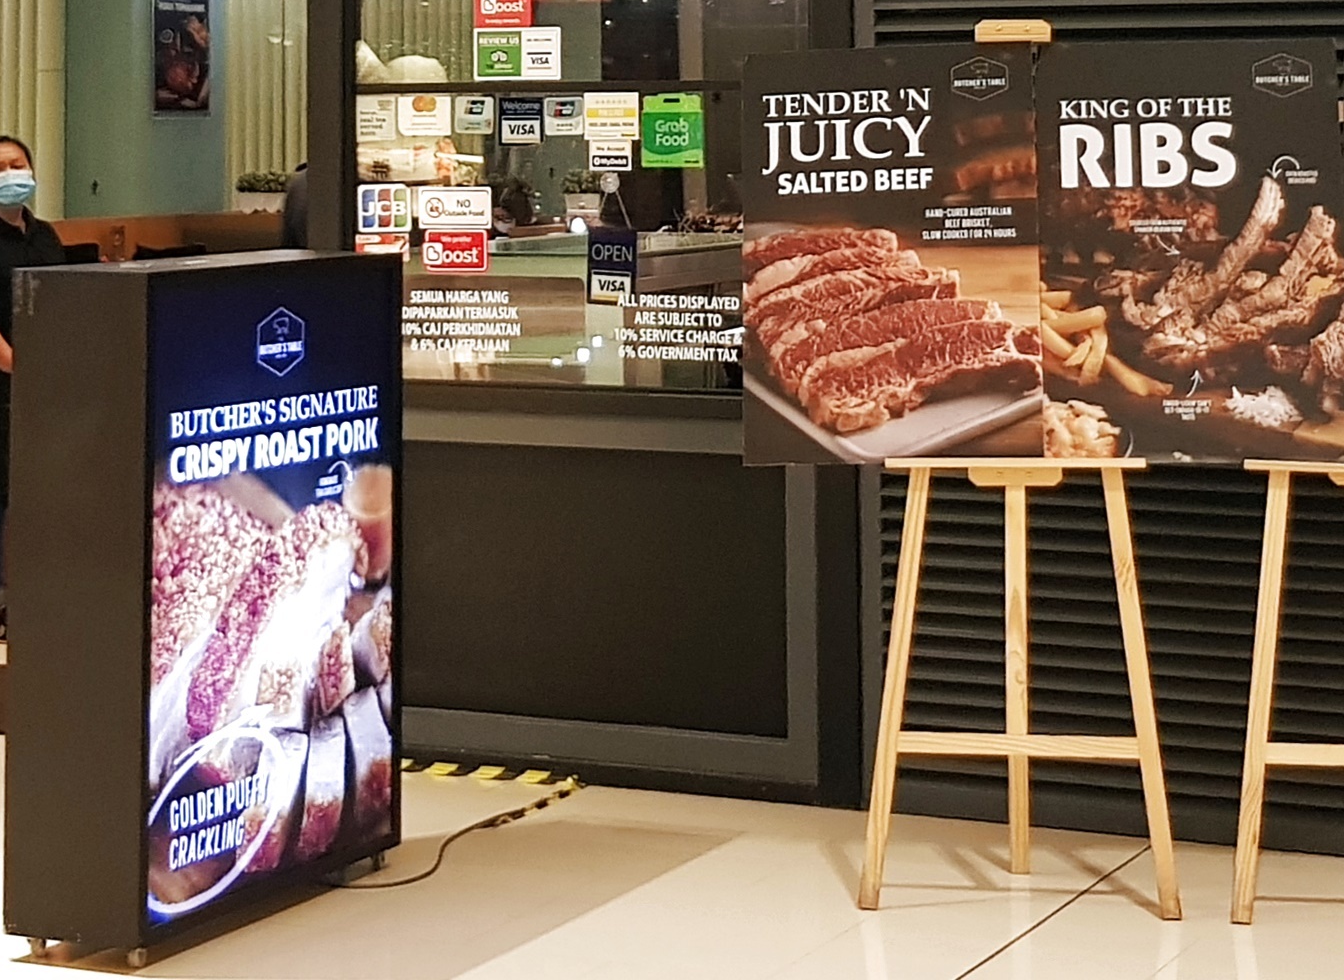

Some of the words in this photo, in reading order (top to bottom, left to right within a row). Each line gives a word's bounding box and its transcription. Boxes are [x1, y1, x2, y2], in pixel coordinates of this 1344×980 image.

[479, 36, 507, 45] REVIEW
[509, 35, 520, 45] US
[531, 57, 550, 65] VISA
[502, 100, 541, 111] Welcome
[762, 89, 892, 118] TENDER
[900, 87, 931, 112] 'N
[1058, 99, 1130, 120] KING
[1136, 98, 1173, 117] OF
[1177, 96, 1233, 117] THE
[508, 123, 536, 136] VISA
[655, 117, 689, 132] Grab
[655, 133, 689, 146] Food
[762, 115, 932, 175] JUICY
[1058, 120, 1238, 189] RIBS
[777, 170, 868, 195] SALTED
[874, 168, 934, 191] BEEF
[362, 201, 407, 216] JCB
[456, 199, 472, 208] NO
[444, 209, 468, 217] Outside
[468, 209, 486, 217] Food
[591, 243, 633, 262] OPEN
[598, 278, 626, 292] VISA
[410, 290, 445, 303] SEMUA
[445, 290, 481, 303] HARGA
[481, 290, 509, 304] YANG
[617, 293, 638, 307] ALL
[639, 294, 677, 309] PRICES
[679, 295, 740, 311] DISPLAYED
[402, 305, 464, 319] DIPAPARKAN
[464, 306, 519, 319] TERMASUK
[634, 311, 657, 325] ARE
[658, 312, 705, 327] SUBJECT
[706, 313, 723, 327] TO
[402, 322, 421, 336] 10%
[422, 322, 441, 336] CAJ
[442, 322, 521, 336] PERKHIDMATAN
[614, 327, 638, 342] 10%
[639, 328, 685, 343] SERVICE
[685, 329, 733, 344] CHARGE
[733, 331, 743, 345] &
[437, 338, 456, 352] CAJ
[617, 345, 636, 358] 6%
[637, 345, 716, 361] GOVERNMENT
[716, 347, 738, 362] TAX
[169, 398, 277, 439] BUTCHER'S
[278, 385, 379, 422] SIGNATURE
[169, 435, 252, 483] CRISPY
[253, 425, 324, 470] ROAST
[325, 416, 379, 458] PORK
[169, 784, 224, 832] GOLDEN
[169, 815, 245, 870] CRACKLING
